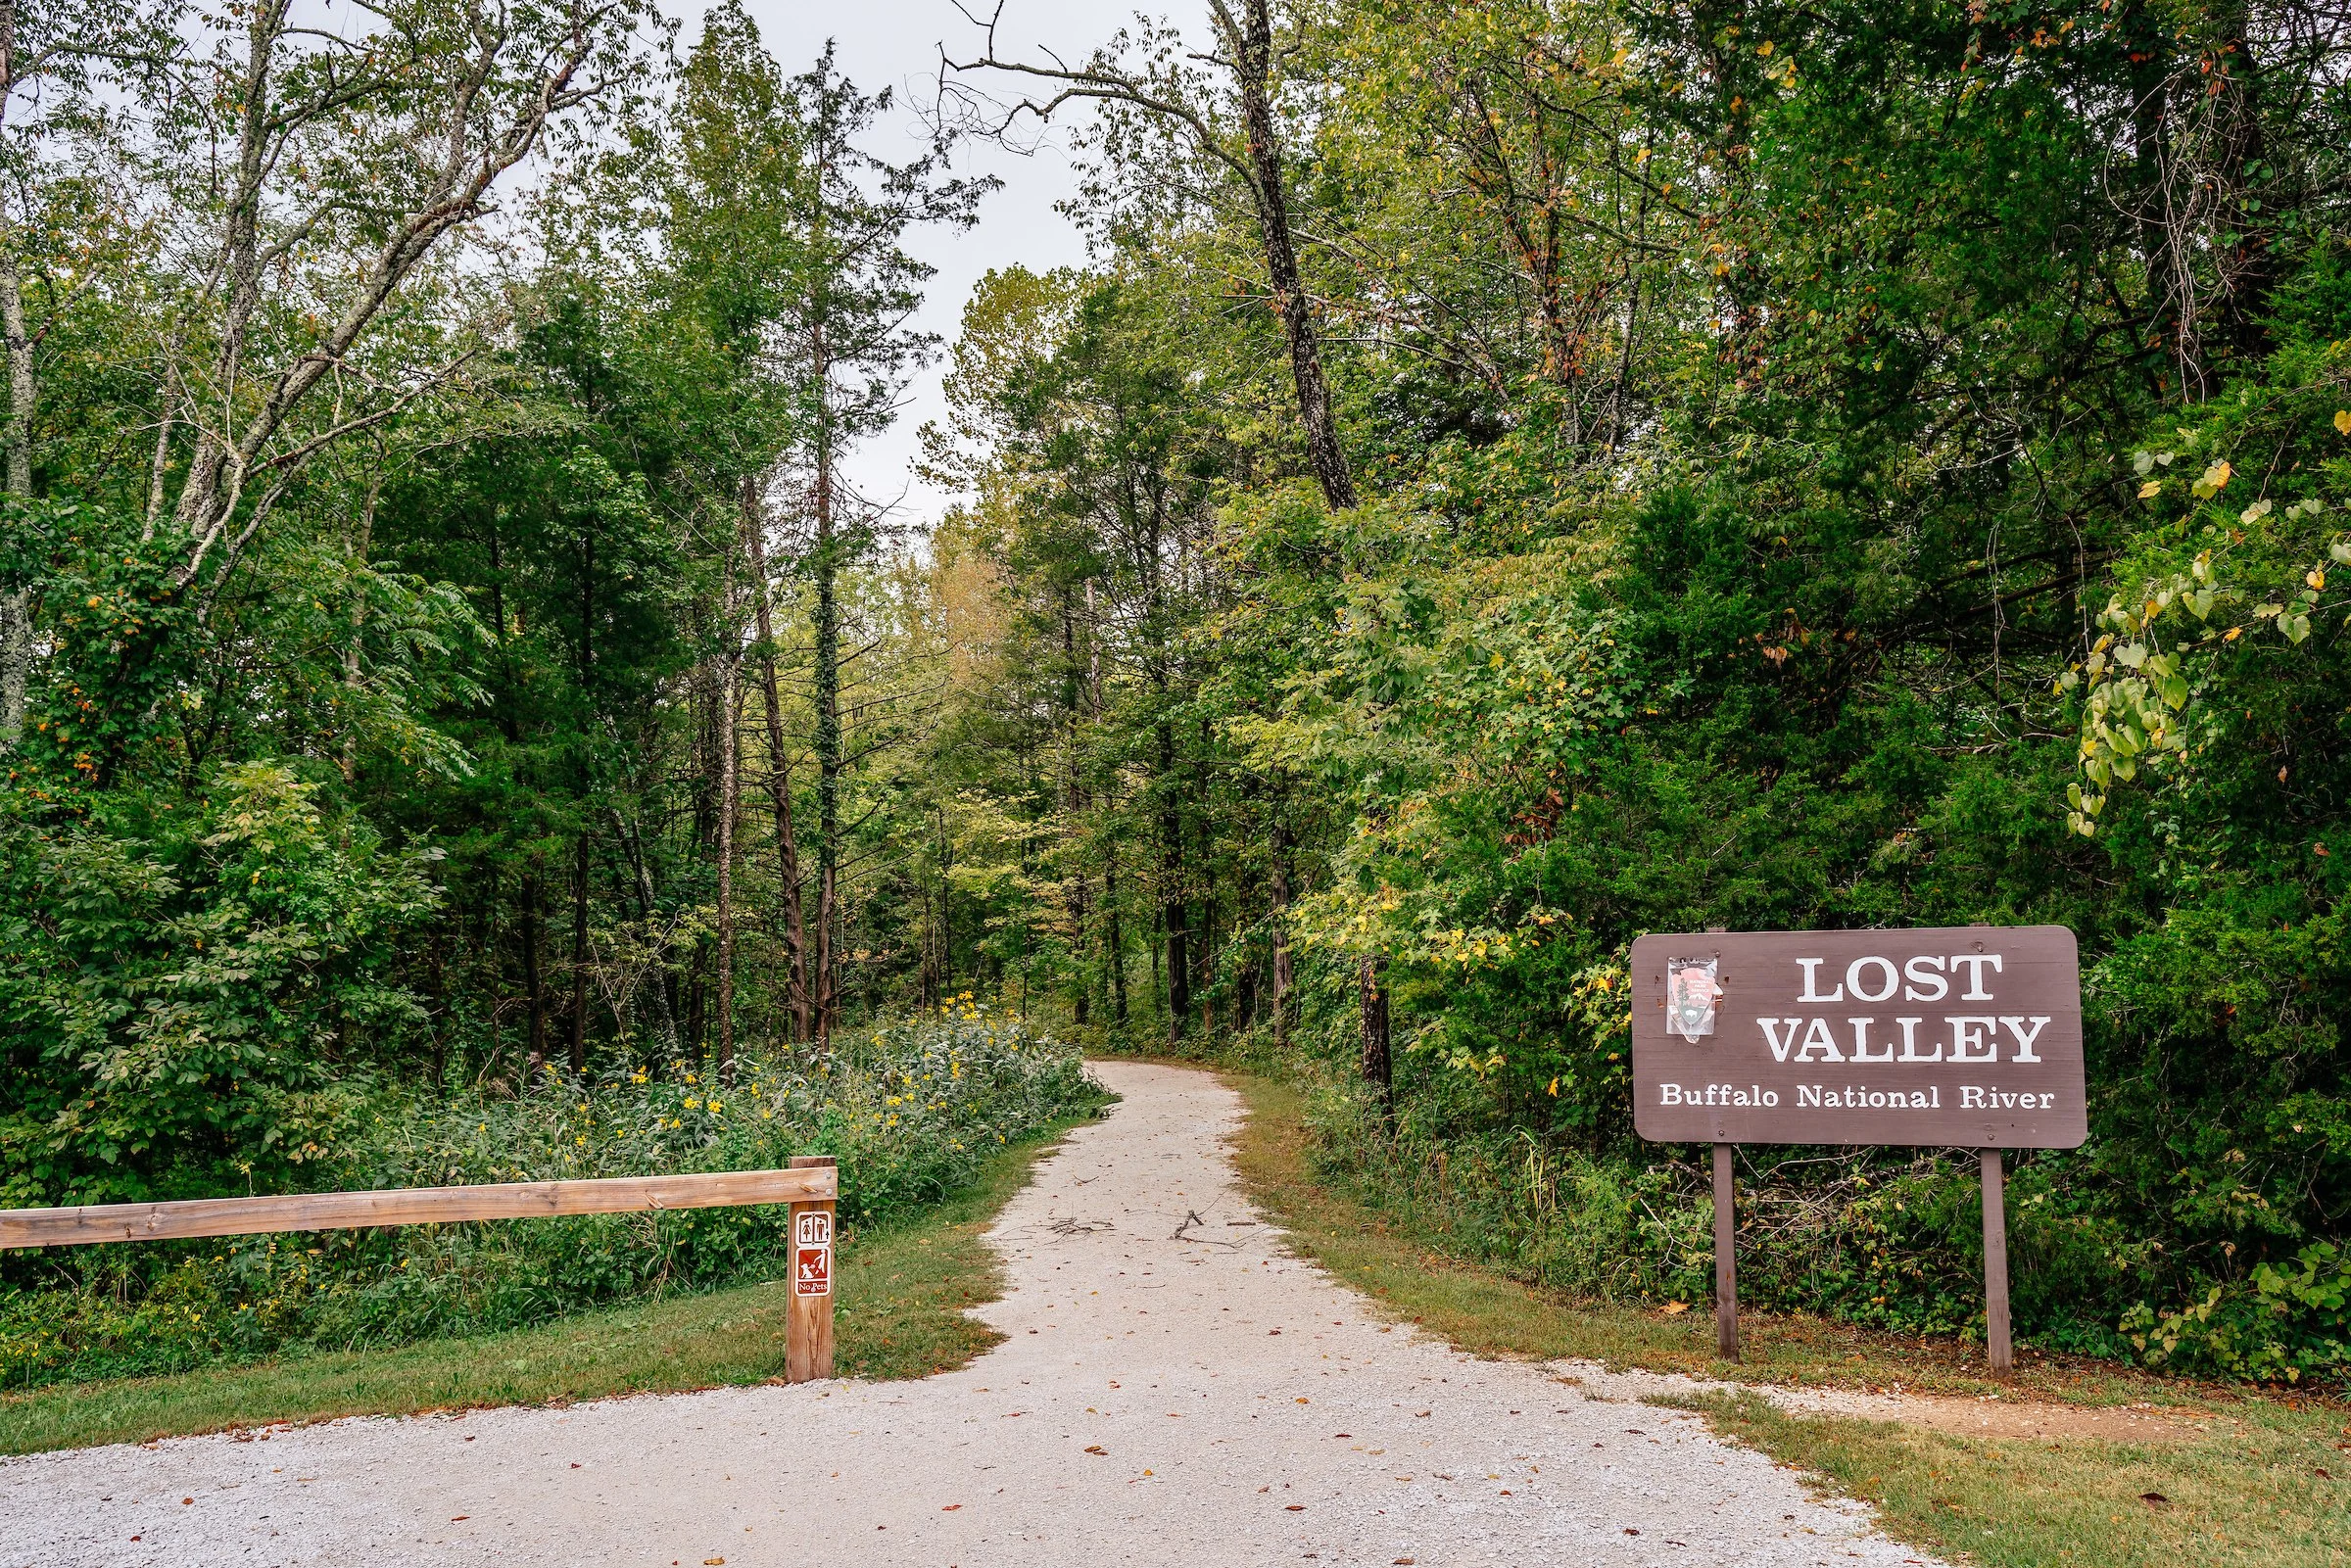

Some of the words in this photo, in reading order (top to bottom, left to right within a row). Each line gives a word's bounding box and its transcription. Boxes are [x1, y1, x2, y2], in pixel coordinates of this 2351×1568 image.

[1796, 954, 2002, 1002] LOST
[1756, 1017, 2051, 1063] VALLEY
[1659, 1083, 1778, 1107] Buffalo
[1797, 1085, 1940, 1108] National
[1959, 1086, 2054, 1109] River
